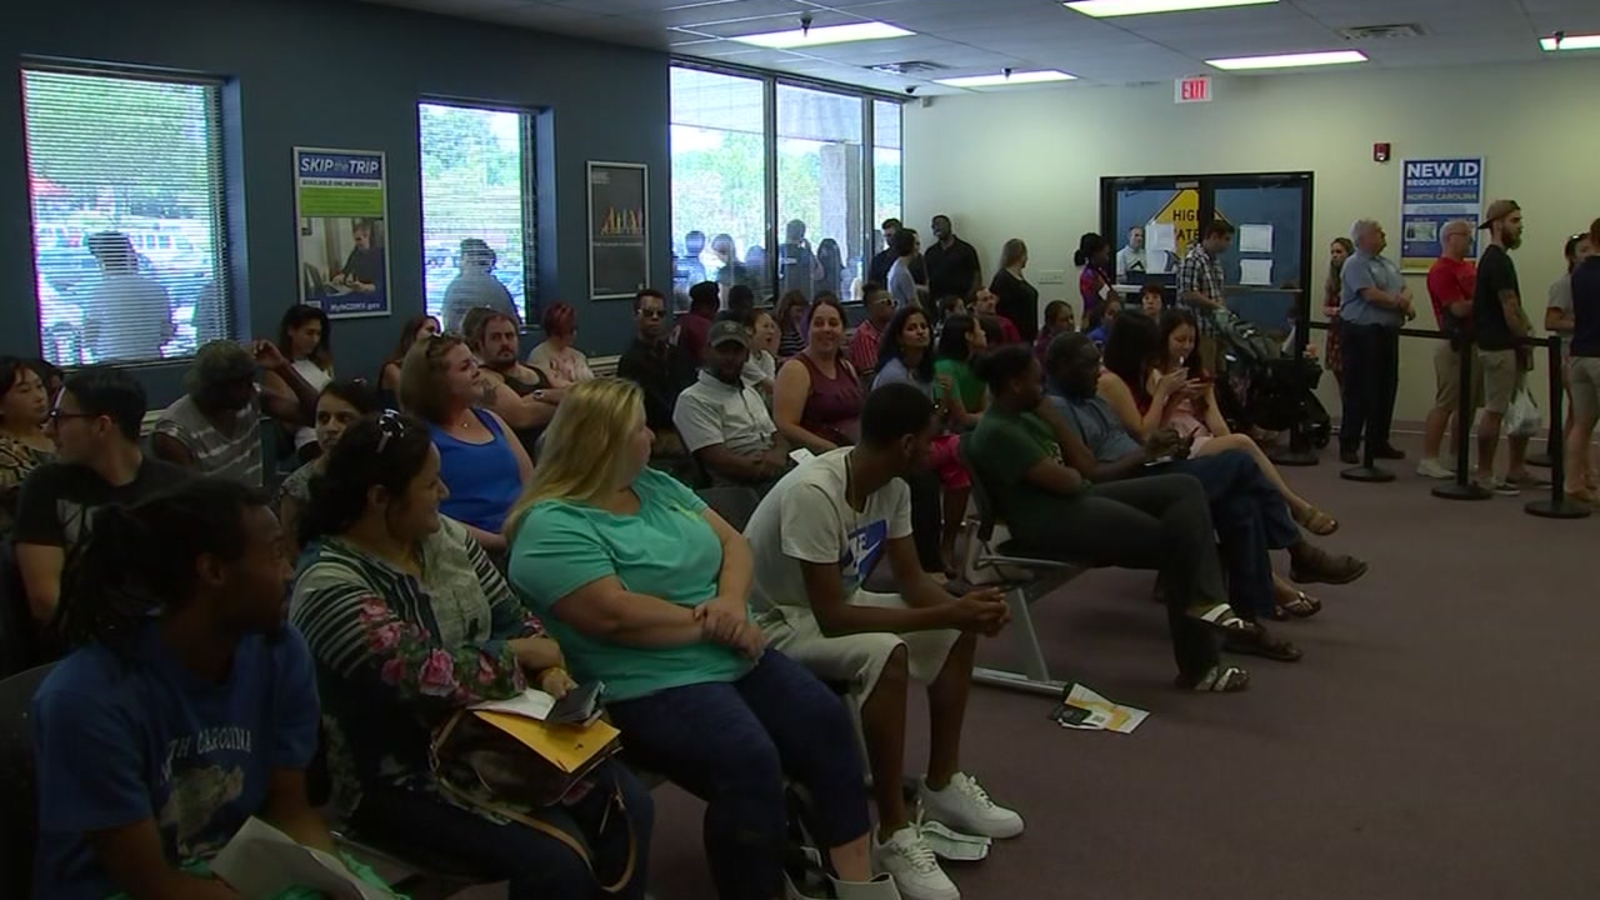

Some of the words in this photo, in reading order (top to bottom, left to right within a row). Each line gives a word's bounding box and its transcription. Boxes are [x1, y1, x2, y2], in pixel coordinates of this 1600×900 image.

[1181, 79, 1207, 100] EXIT
[301, 158, 334, 172] SKIP
[349, 160, 380, 174] TRIP
[1407, 162, 1454, 178] NEW
[1458, 162, 1479, 177] ID
[1406, 178, 1478, 187] REQUIREMENTS
[1175, 228, 1200, 241] ATE
